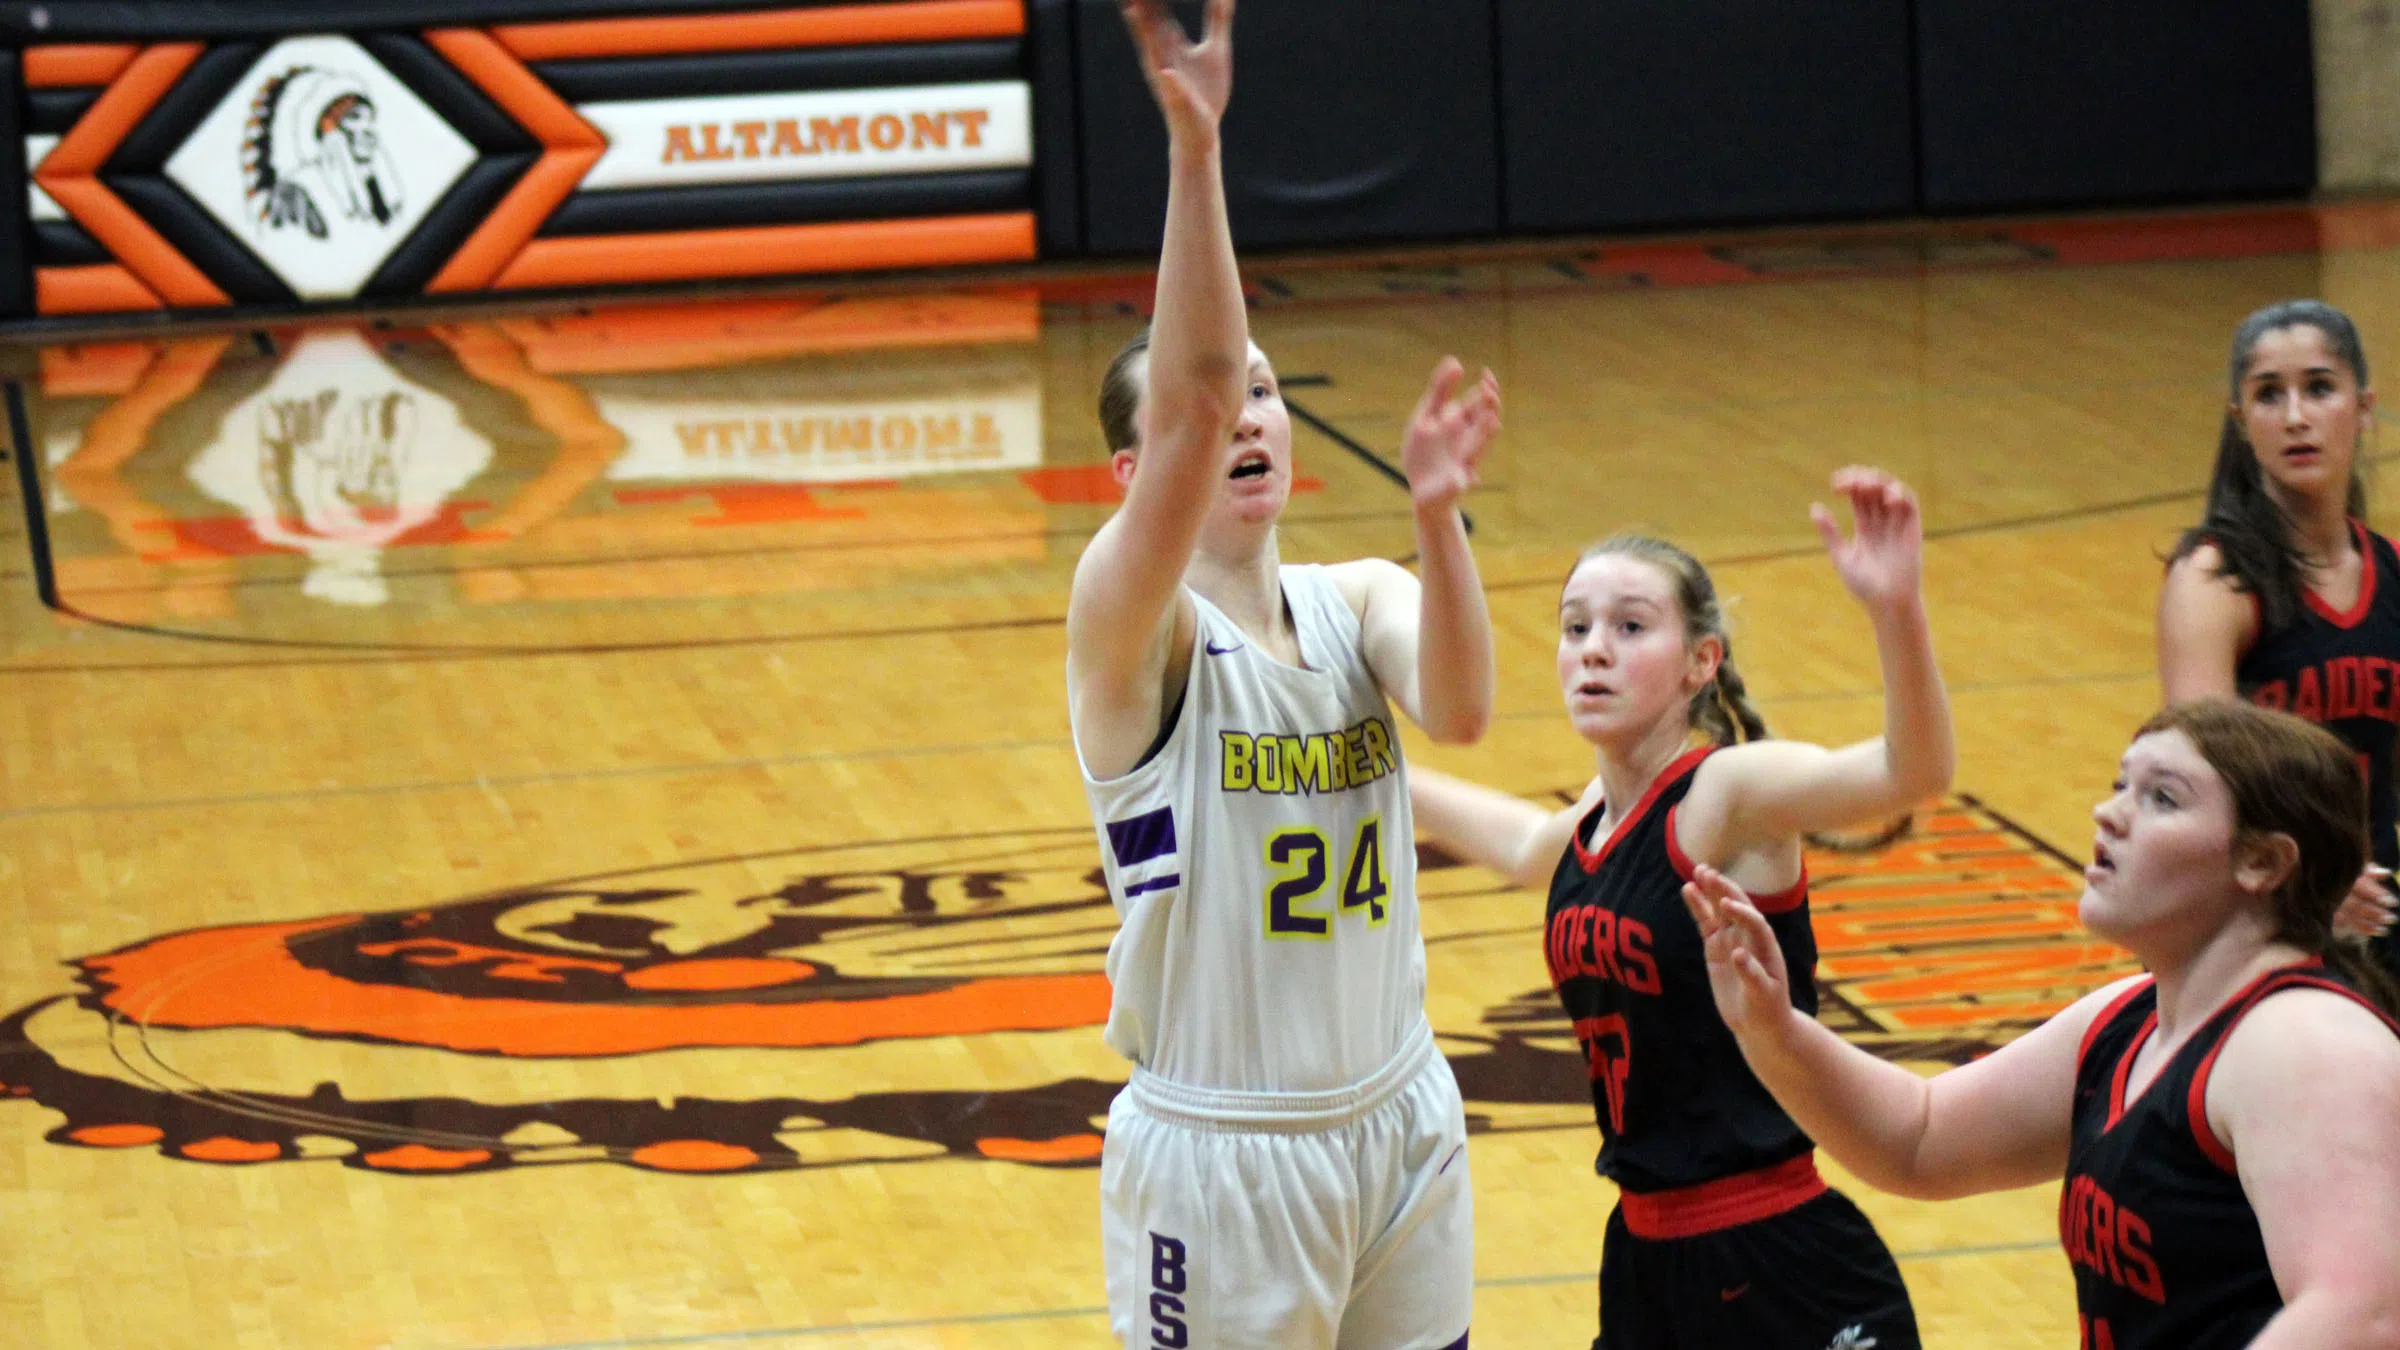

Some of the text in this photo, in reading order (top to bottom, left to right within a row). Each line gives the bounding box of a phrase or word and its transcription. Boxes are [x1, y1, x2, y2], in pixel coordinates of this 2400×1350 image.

[661, 109, 989, 164] ALTAMONT
[2252, 655, 2400, 726] RAIDE
[1219, 717, 1397, 798] BOMBER
[1264, 812, 1393, 941] 24
[1542, 904, 1663, 995] IDERS
[1148, 1230, 1188, 1350] BS
